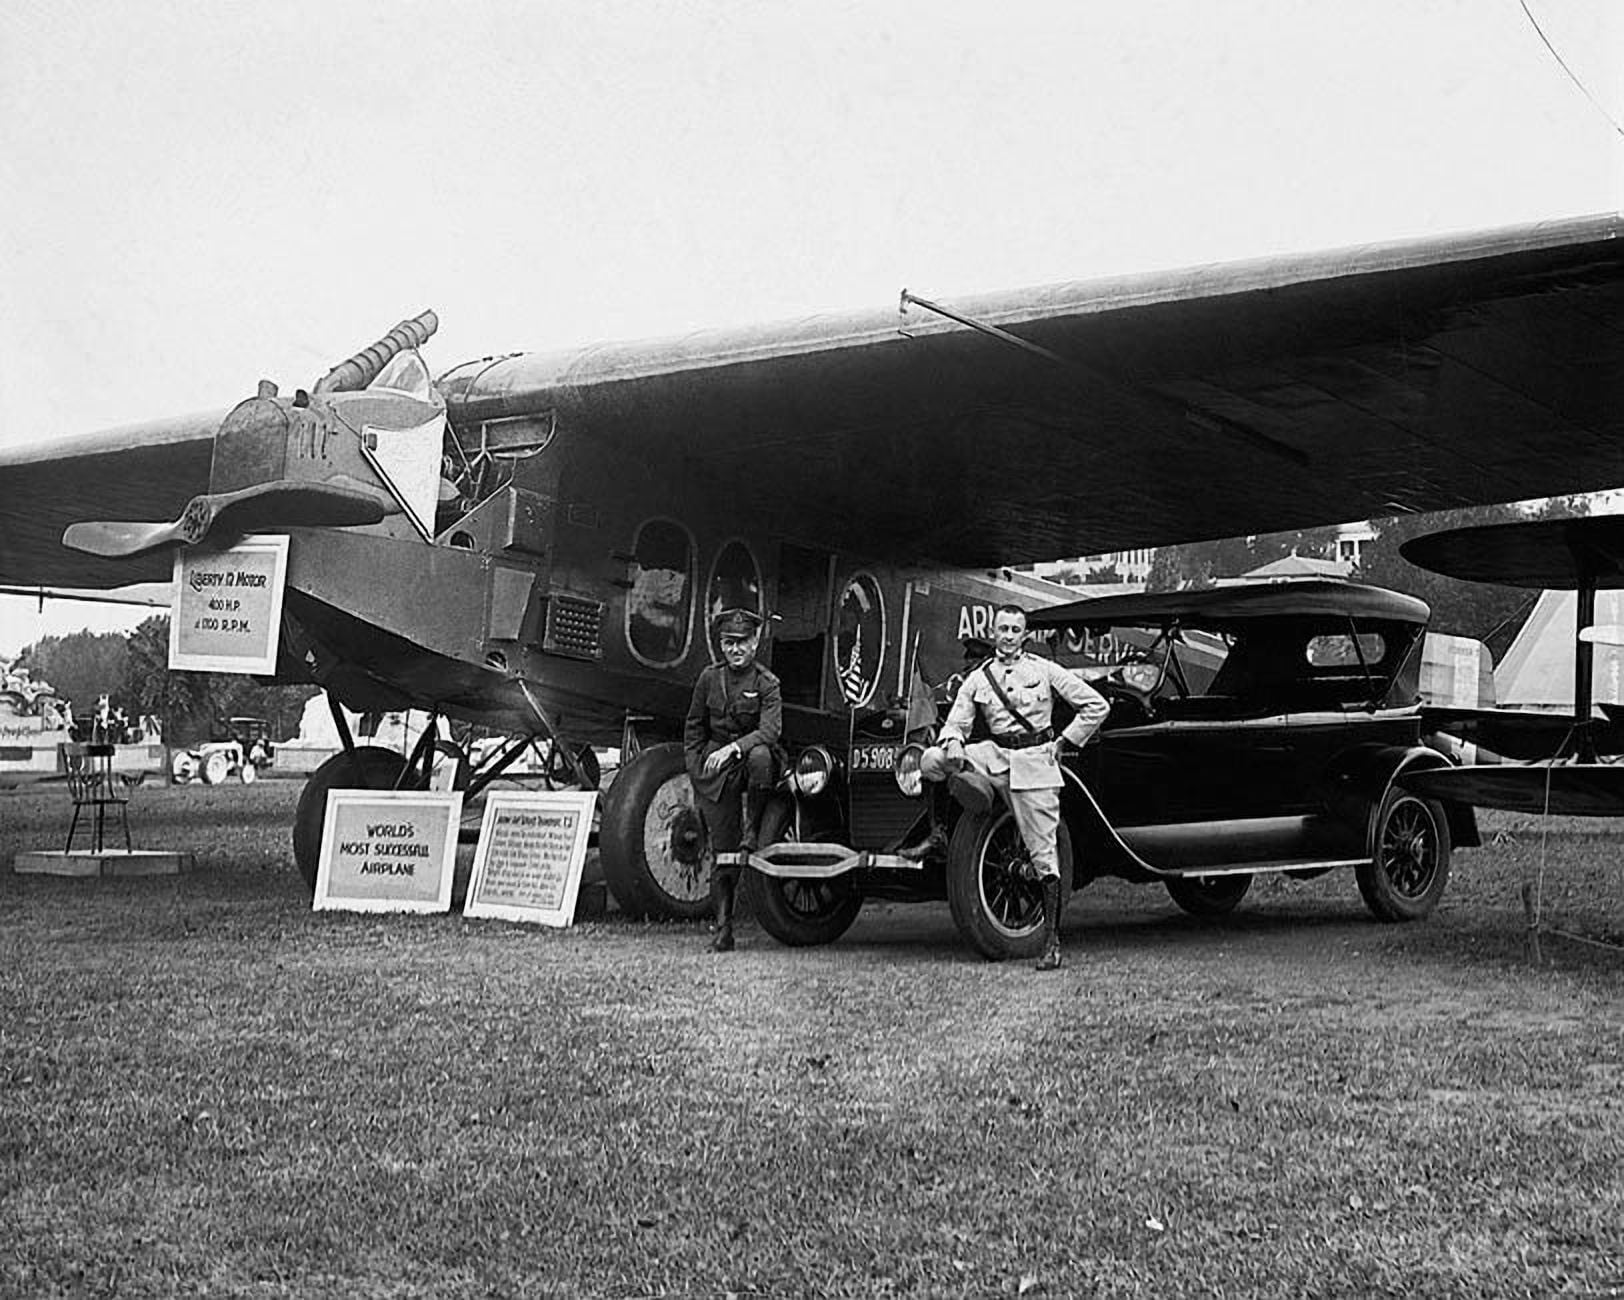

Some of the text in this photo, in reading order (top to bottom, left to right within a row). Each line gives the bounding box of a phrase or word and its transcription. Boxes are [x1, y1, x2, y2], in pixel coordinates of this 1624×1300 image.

[367, 822, 415, 838] WORLD'S
[340, 842, 371, 856] MOST
[361, 862, 415, 876] AIRPLANE
